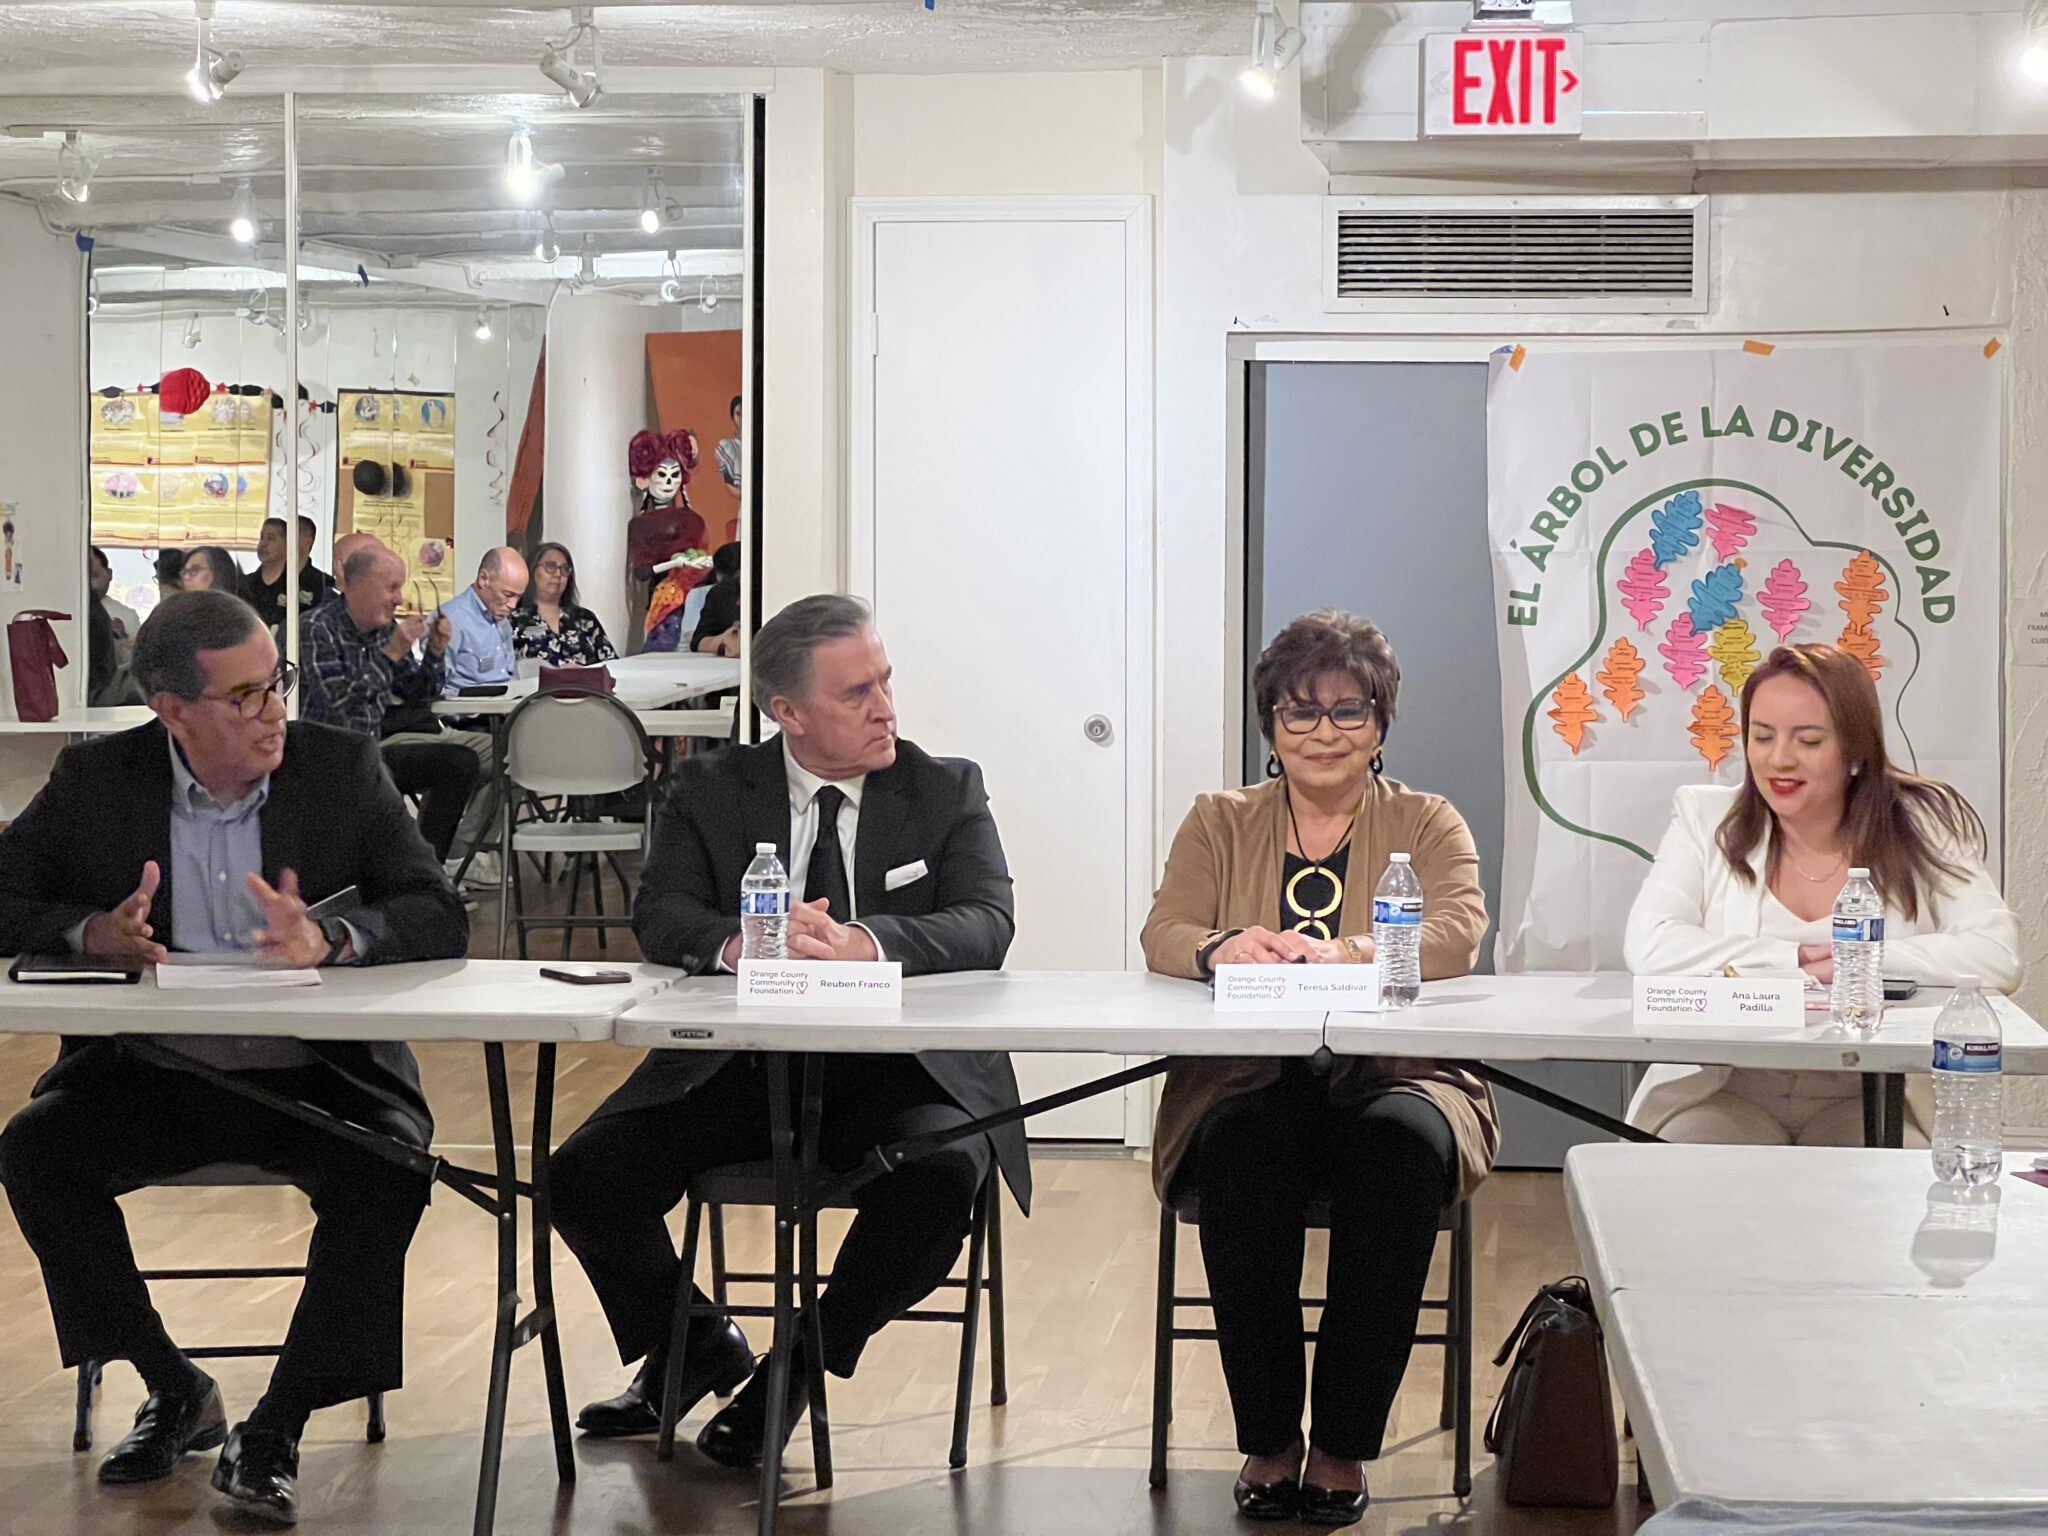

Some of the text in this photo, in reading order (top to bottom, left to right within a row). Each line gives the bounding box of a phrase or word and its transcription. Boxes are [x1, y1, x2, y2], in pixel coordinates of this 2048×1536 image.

[1453, 39, 1566, 125] EXIT
[1701, 404, 1755, 438] LA
[1629, 411, 1688, 457] DE
[1509, 446, 1628, 572] ÁRBOL
[1768, 409, 1957, 624] DIVERSIDAD
[1507, 582, 1541, 626] EL
[750, 971, 808, 979] Orange County
[1227, 975, 1286, 984] Orange County
[750, 979, 795, 987] Community
[820, 979, 890, 989] Reuben Franco
[1297, 983, 1368, 991] Teresa Saldivar
[1227, 984, 1272, 992] Community
[1646, 987, 1707, 996] Orange County
[1227, 992, 1271, 1000] Foundation
[1646, 996, 1694, 1004] Community
[1731, 991, 1781, 1000] Ana Laura
[1647, 1004, 1692, 1012] Foundation
[1739, 1003, 1773, 1012] Padilla
